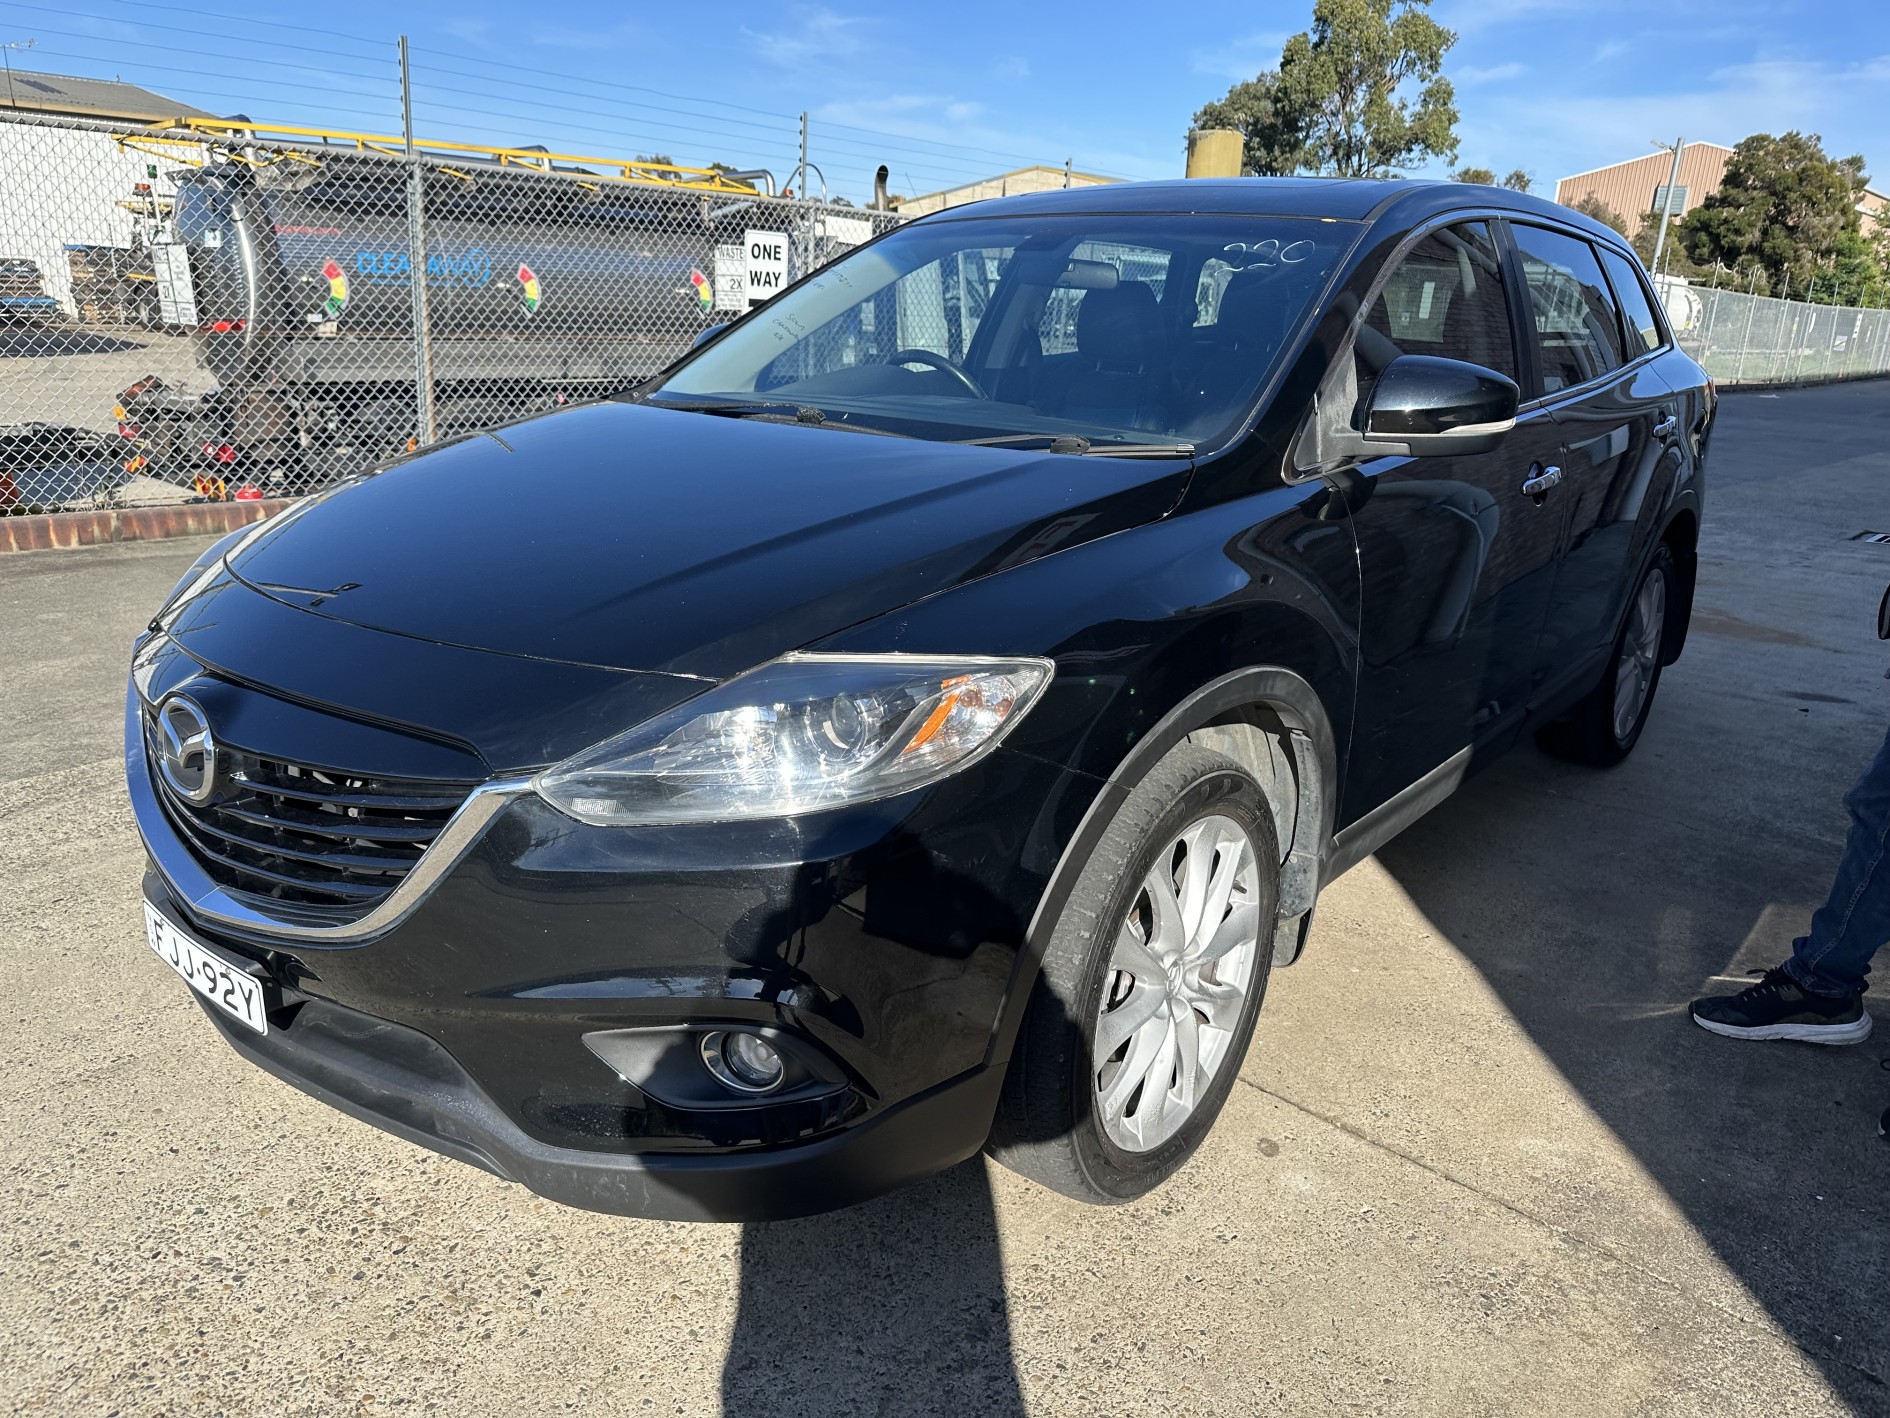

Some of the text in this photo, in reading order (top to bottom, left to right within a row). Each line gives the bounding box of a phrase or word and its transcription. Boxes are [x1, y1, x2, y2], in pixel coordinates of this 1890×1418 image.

[751, 243, 782, 261] ONE
[1214, 238, 1316, 276] 220
[356, 251, 483, 277] CLEAAWAY
[749, 270, 782, 288] WAY
